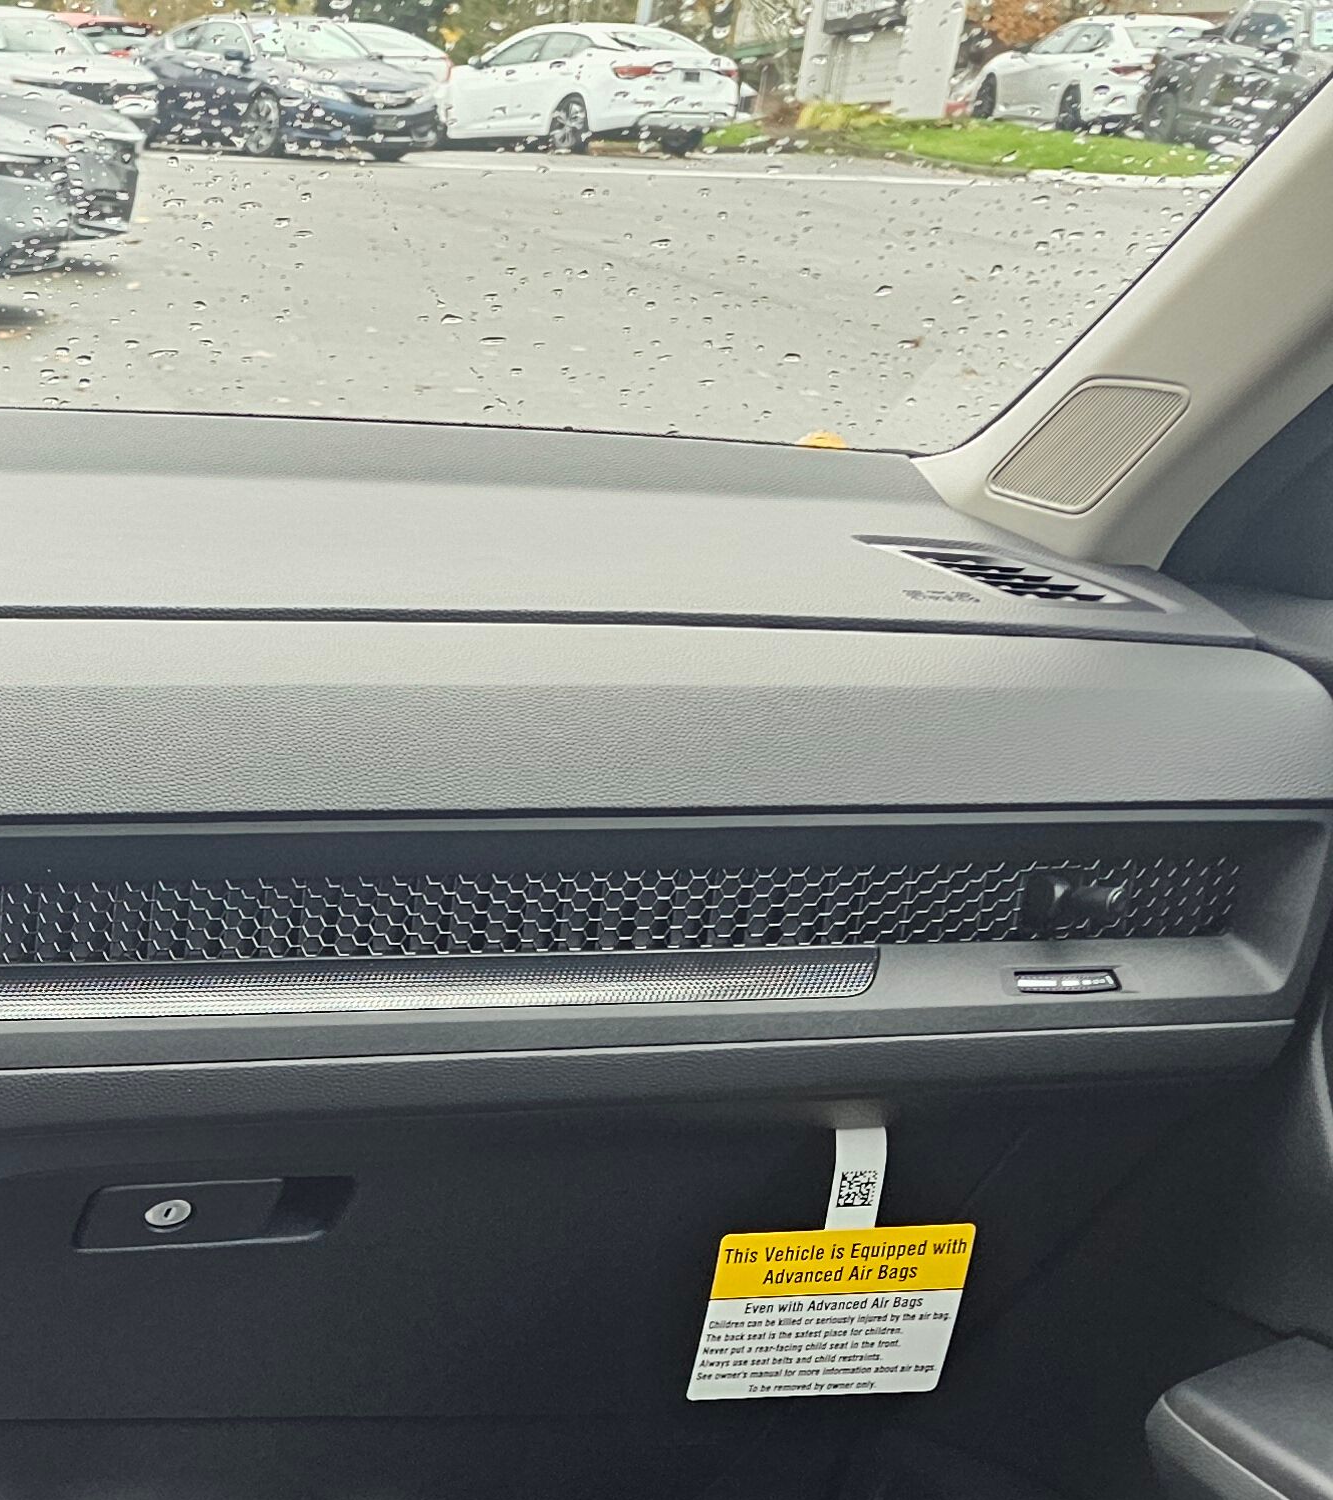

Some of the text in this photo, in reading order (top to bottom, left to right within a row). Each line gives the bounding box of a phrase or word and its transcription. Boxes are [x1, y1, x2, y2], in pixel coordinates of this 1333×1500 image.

[725, 1238, 967, 1264] This Vehicle is Equipped with
[763, 1265, 918, 1284] Advanced Air Bags
[744, 1297, 923, 1314] Even with Advanced Air Bags
[708, 1320, 744, 1329] Children
[747, 1320, 763, 1328] can
[765, 1319, 775, 1327] be
[778, 1317, 802, 1326] killed
[816, 1315, 855, 1325] seriously
[857, 1313, 888, 1324] injured
[890, 1314, 900, 1323] by
[903, 1313, 915, 1321] the
[918, 1312, 931, 1320] air
[933, 1312, 951, 1321] bag.
[706, 1327, 903, 1342] The back seat is the safest place for children.
[702, 1346, 728, 1355] Never
[730, 1346, 745, 1355] put
[755, 1343, 803, 1353] rear-facing
[805, 1342, 827, 1351] child
[829, 1341, 848, 1350] seat
[850, 1341, 859, 1349] in
[861, 1340, 875, 1348] the
[877, 1339, 901, 1348] front.
[699, 1359, 730, 1369] Always
[750, 1357, 770, 1366] seat
[772, 1356, 793, 1365] belts
[795, 1355, 812, 1364] and
[814, 1354, 836, 1363] child
[838, 1353, 883, 1362] restraints.
[696, 1364, 937, 1380] See owner's manual for more information about air bags.
[748, 1384, 758, 1392] To
[773, 1382, 812, 1391] removed
[814, 1382, 825, 1392] by
[826, 1382, 854, 1390] owner
[856, 1380, 877, 1389] only.
